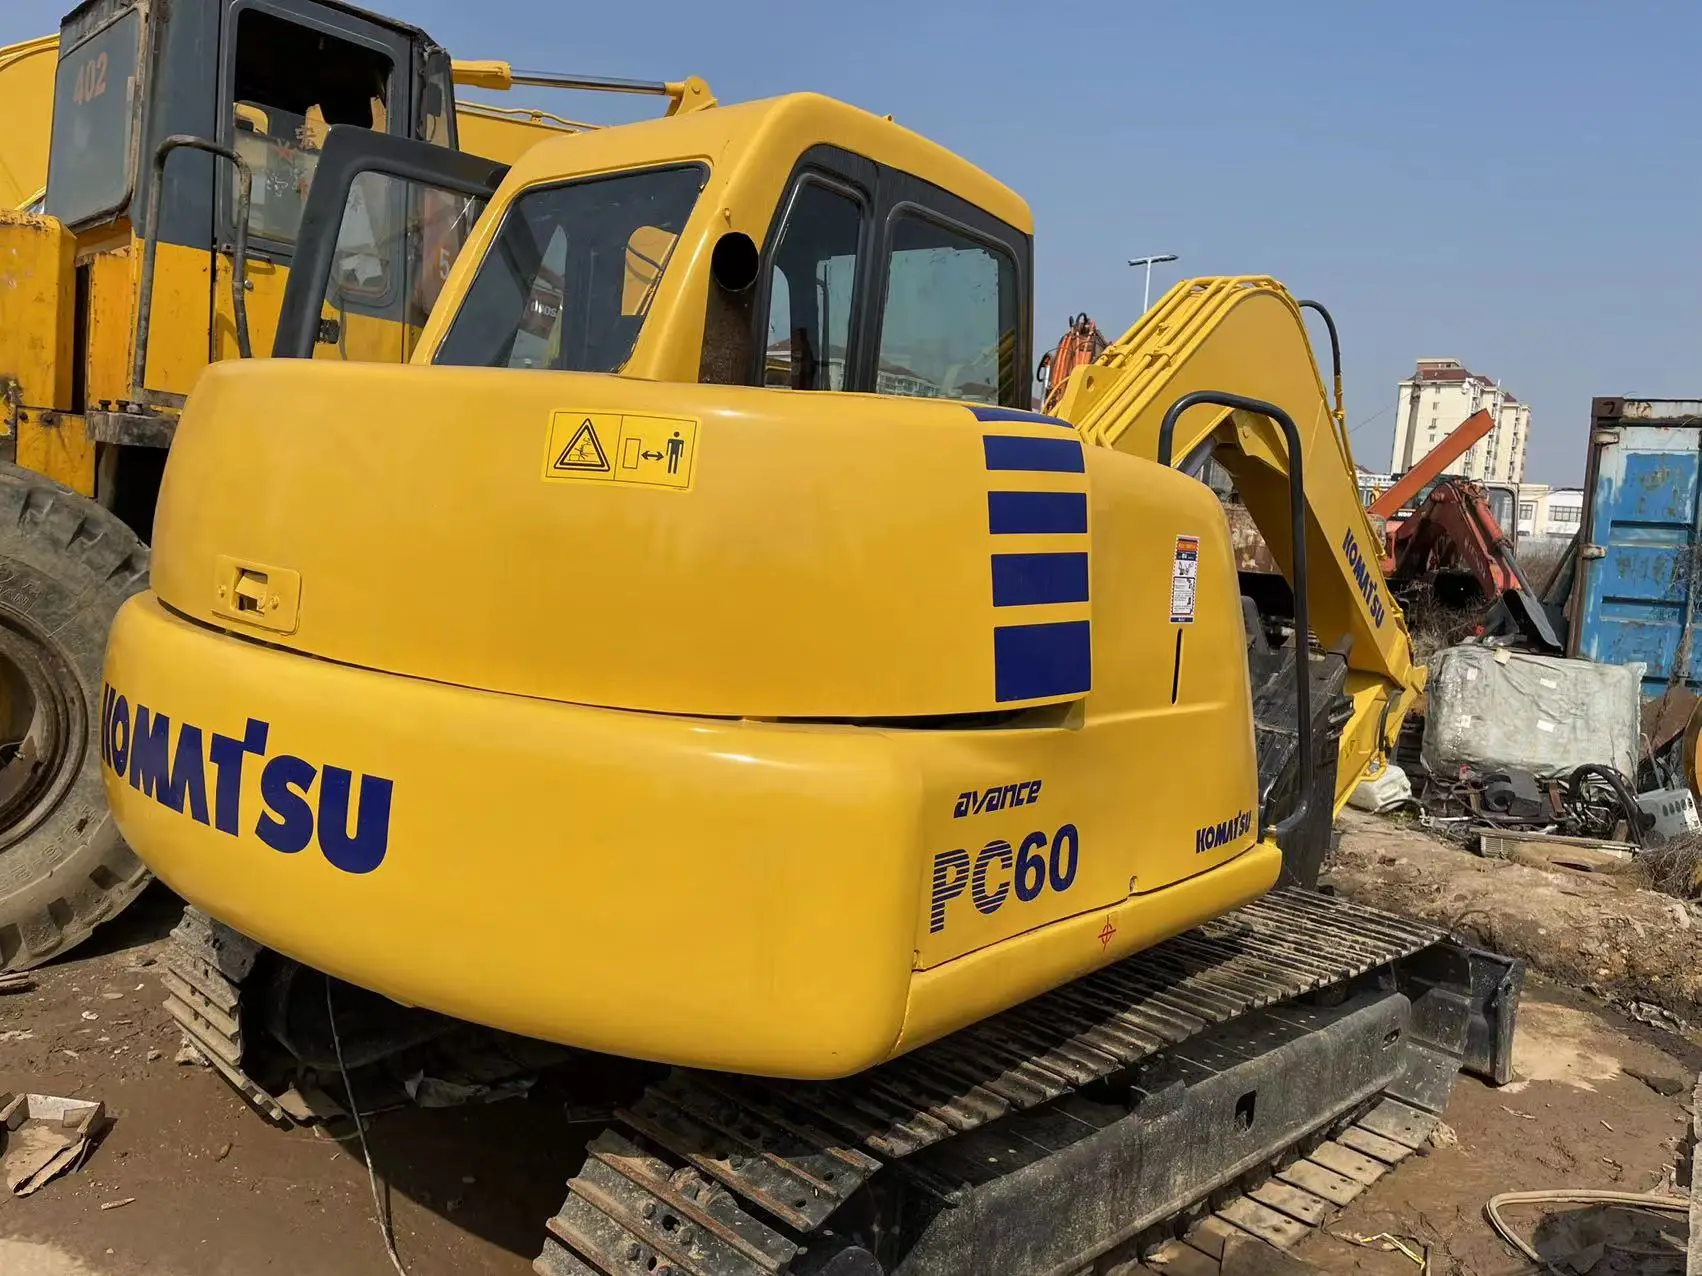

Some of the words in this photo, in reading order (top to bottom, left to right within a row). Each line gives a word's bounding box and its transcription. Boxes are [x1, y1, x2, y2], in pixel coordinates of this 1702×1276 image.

[1342, 525, 1385, 629] KOMATSU
[101, 681, 394, 874] KOMATSU
[953, 780, 1042, 819] avance
[930, 823, 1079, 934] PC60
[1196, 809, 1252, 854] KOMATSU
